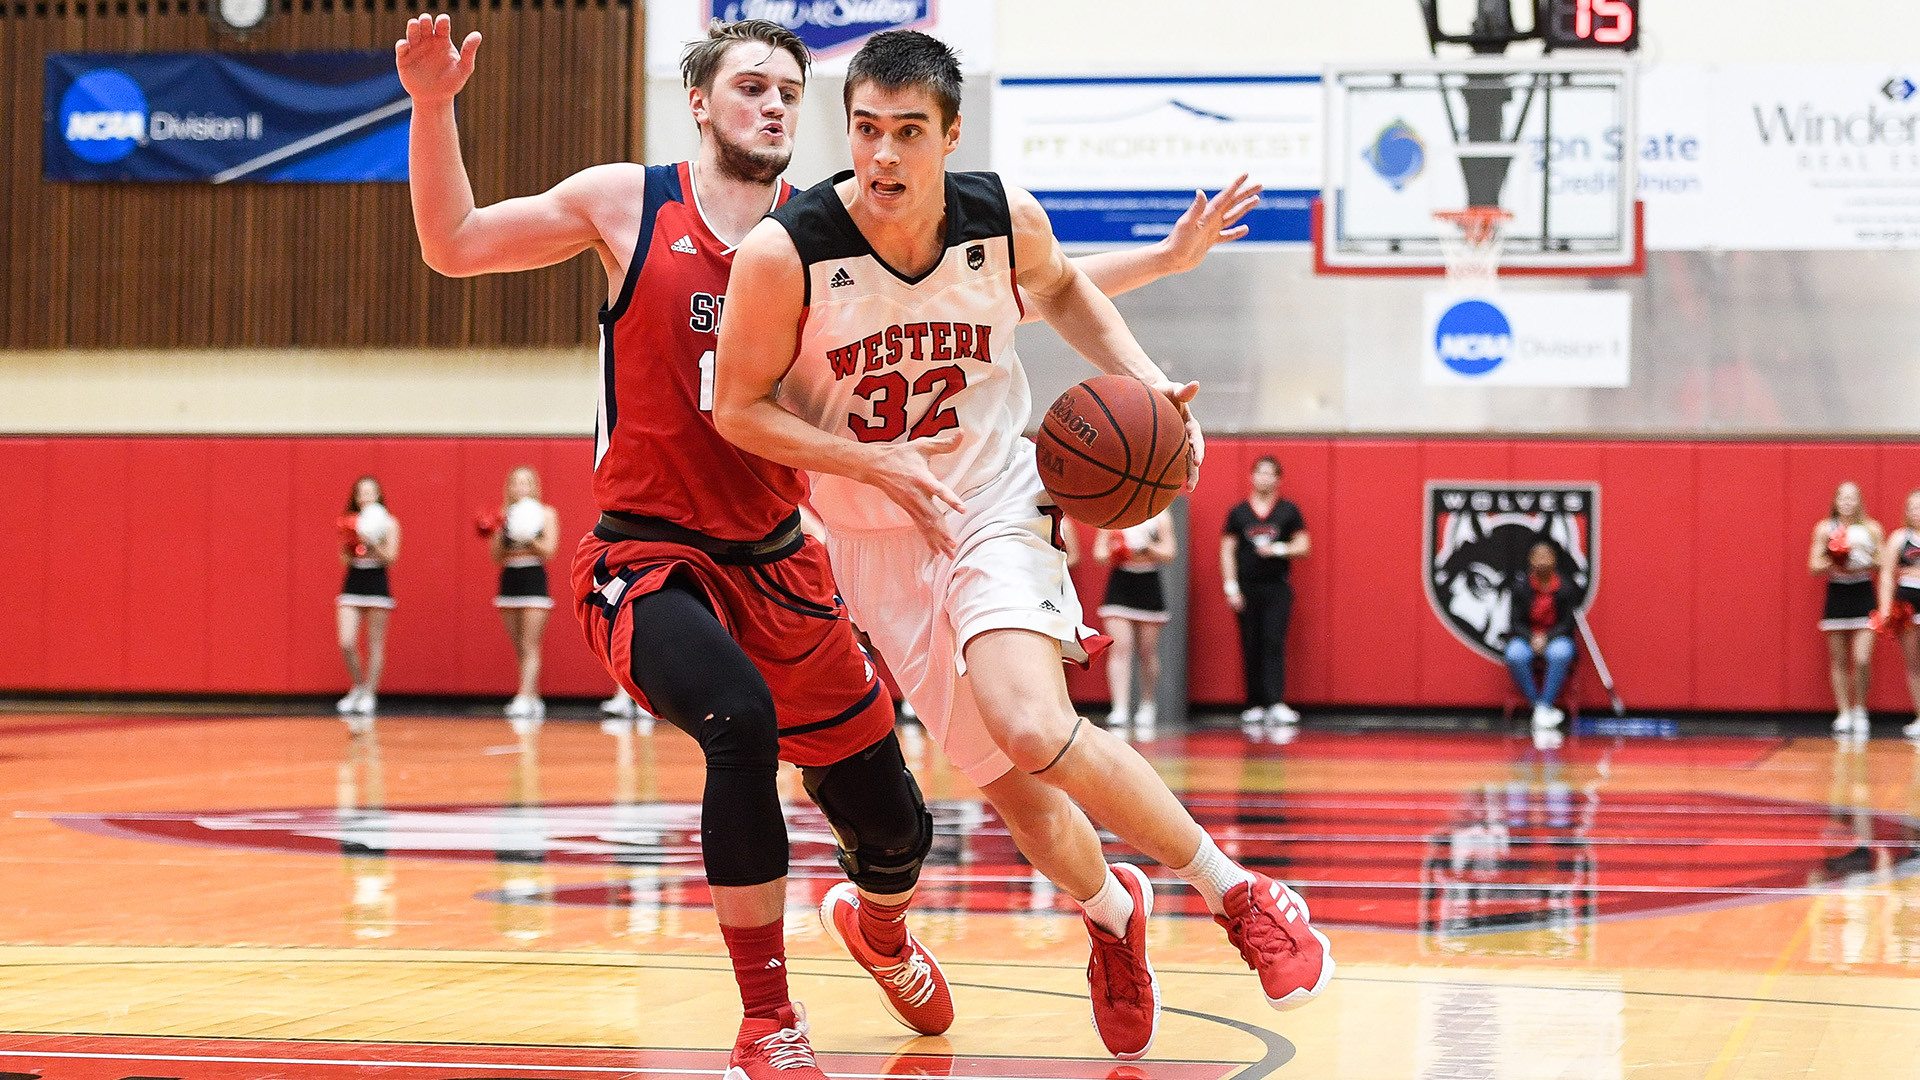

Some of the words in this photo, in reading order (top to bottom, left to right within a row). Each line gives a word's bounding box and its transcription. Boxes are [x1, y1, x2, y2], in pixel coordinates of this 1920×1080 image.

[1575, 0, 1633, 43] 15
[149, 111, 245, 141] Division
[1603, 126, 1699, 162] Sate
[826, 321, 993, 381] WESTERN
[847, 363, 968, 444] 32
[1442, 490, 1584, 513] WOLVES
